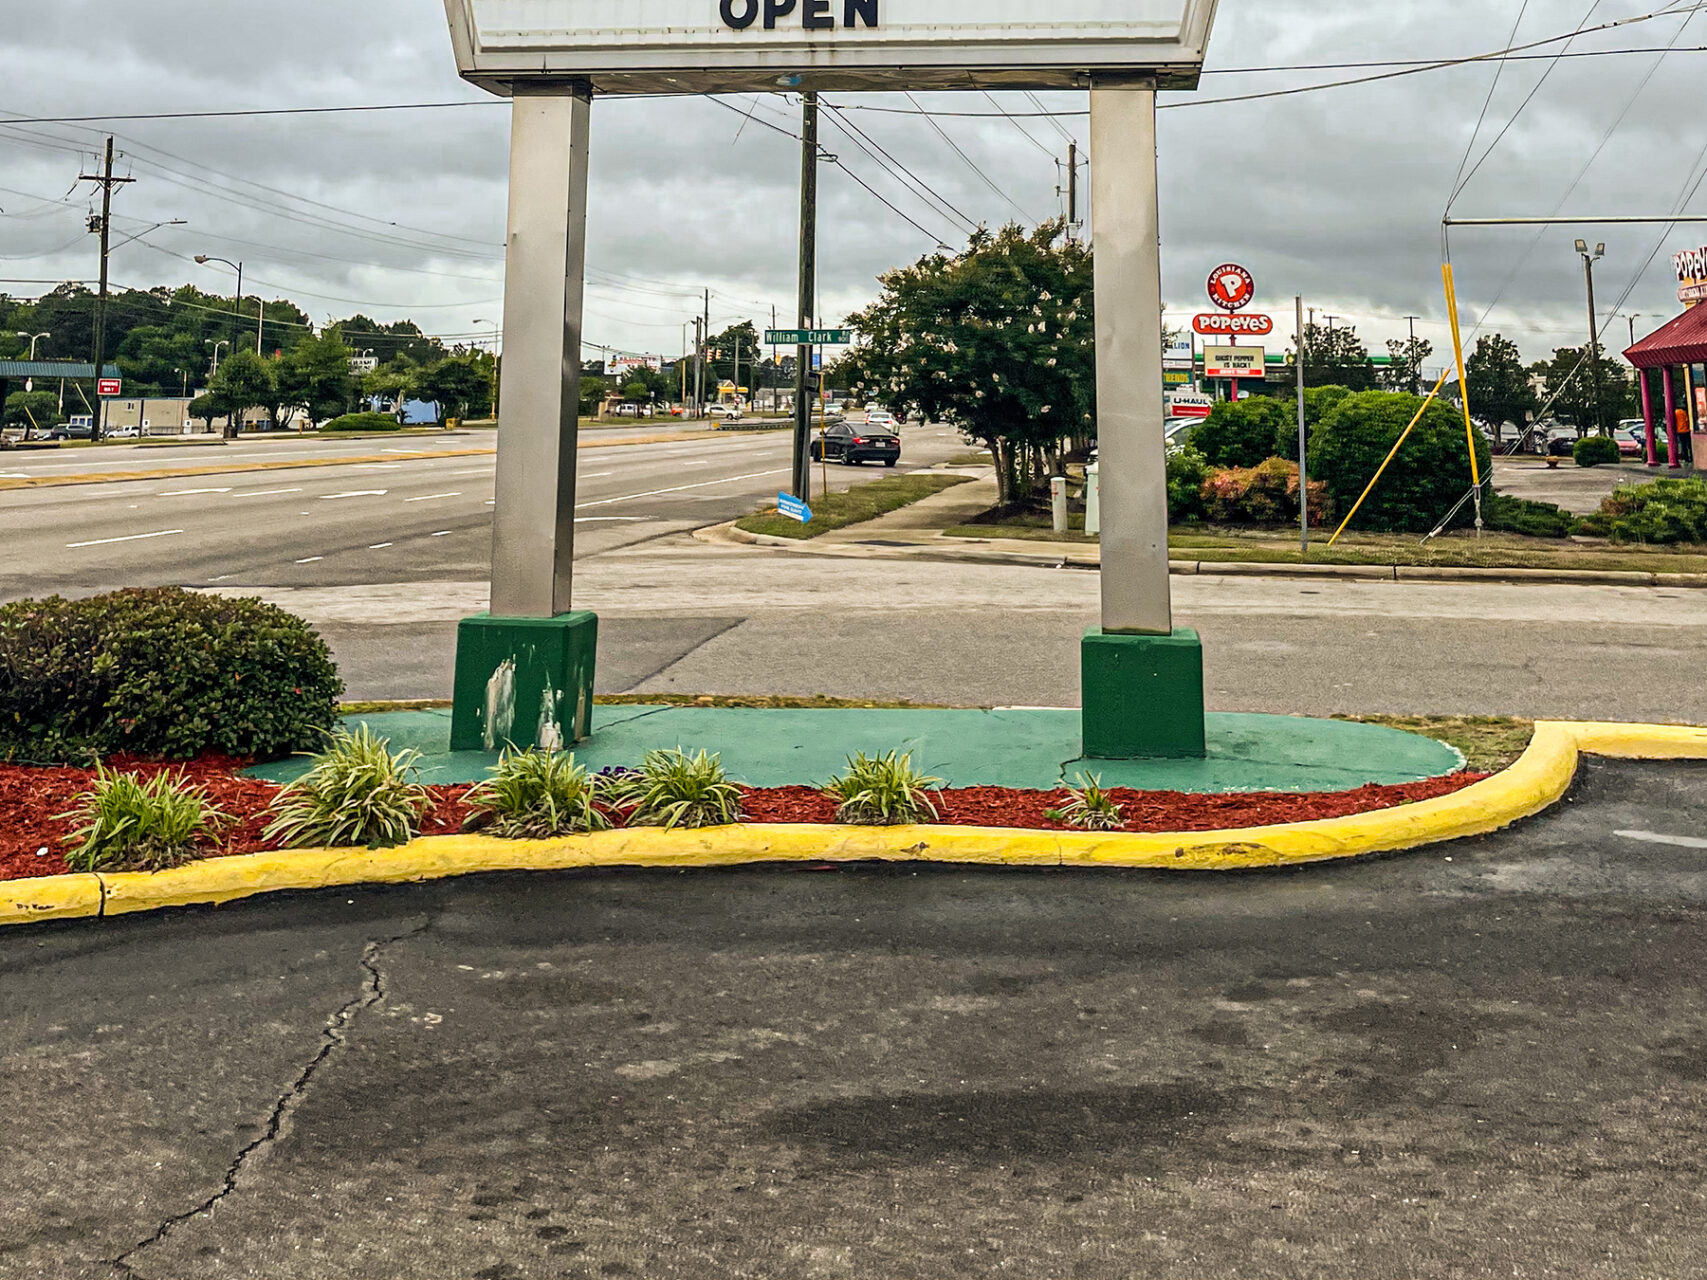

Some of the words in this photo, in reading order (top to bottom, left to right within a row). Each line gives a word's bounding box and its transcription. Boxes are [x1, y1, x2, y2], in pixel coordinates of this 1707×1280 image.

[1210, 266, 1251, 284] LOUISIANA
[1212, 293, 1250, 308] KITCHEN
[766, 331, 798, 342] William
[808, 331, 832, 342] Clark
[1174, 342, 1190, 350] LION
